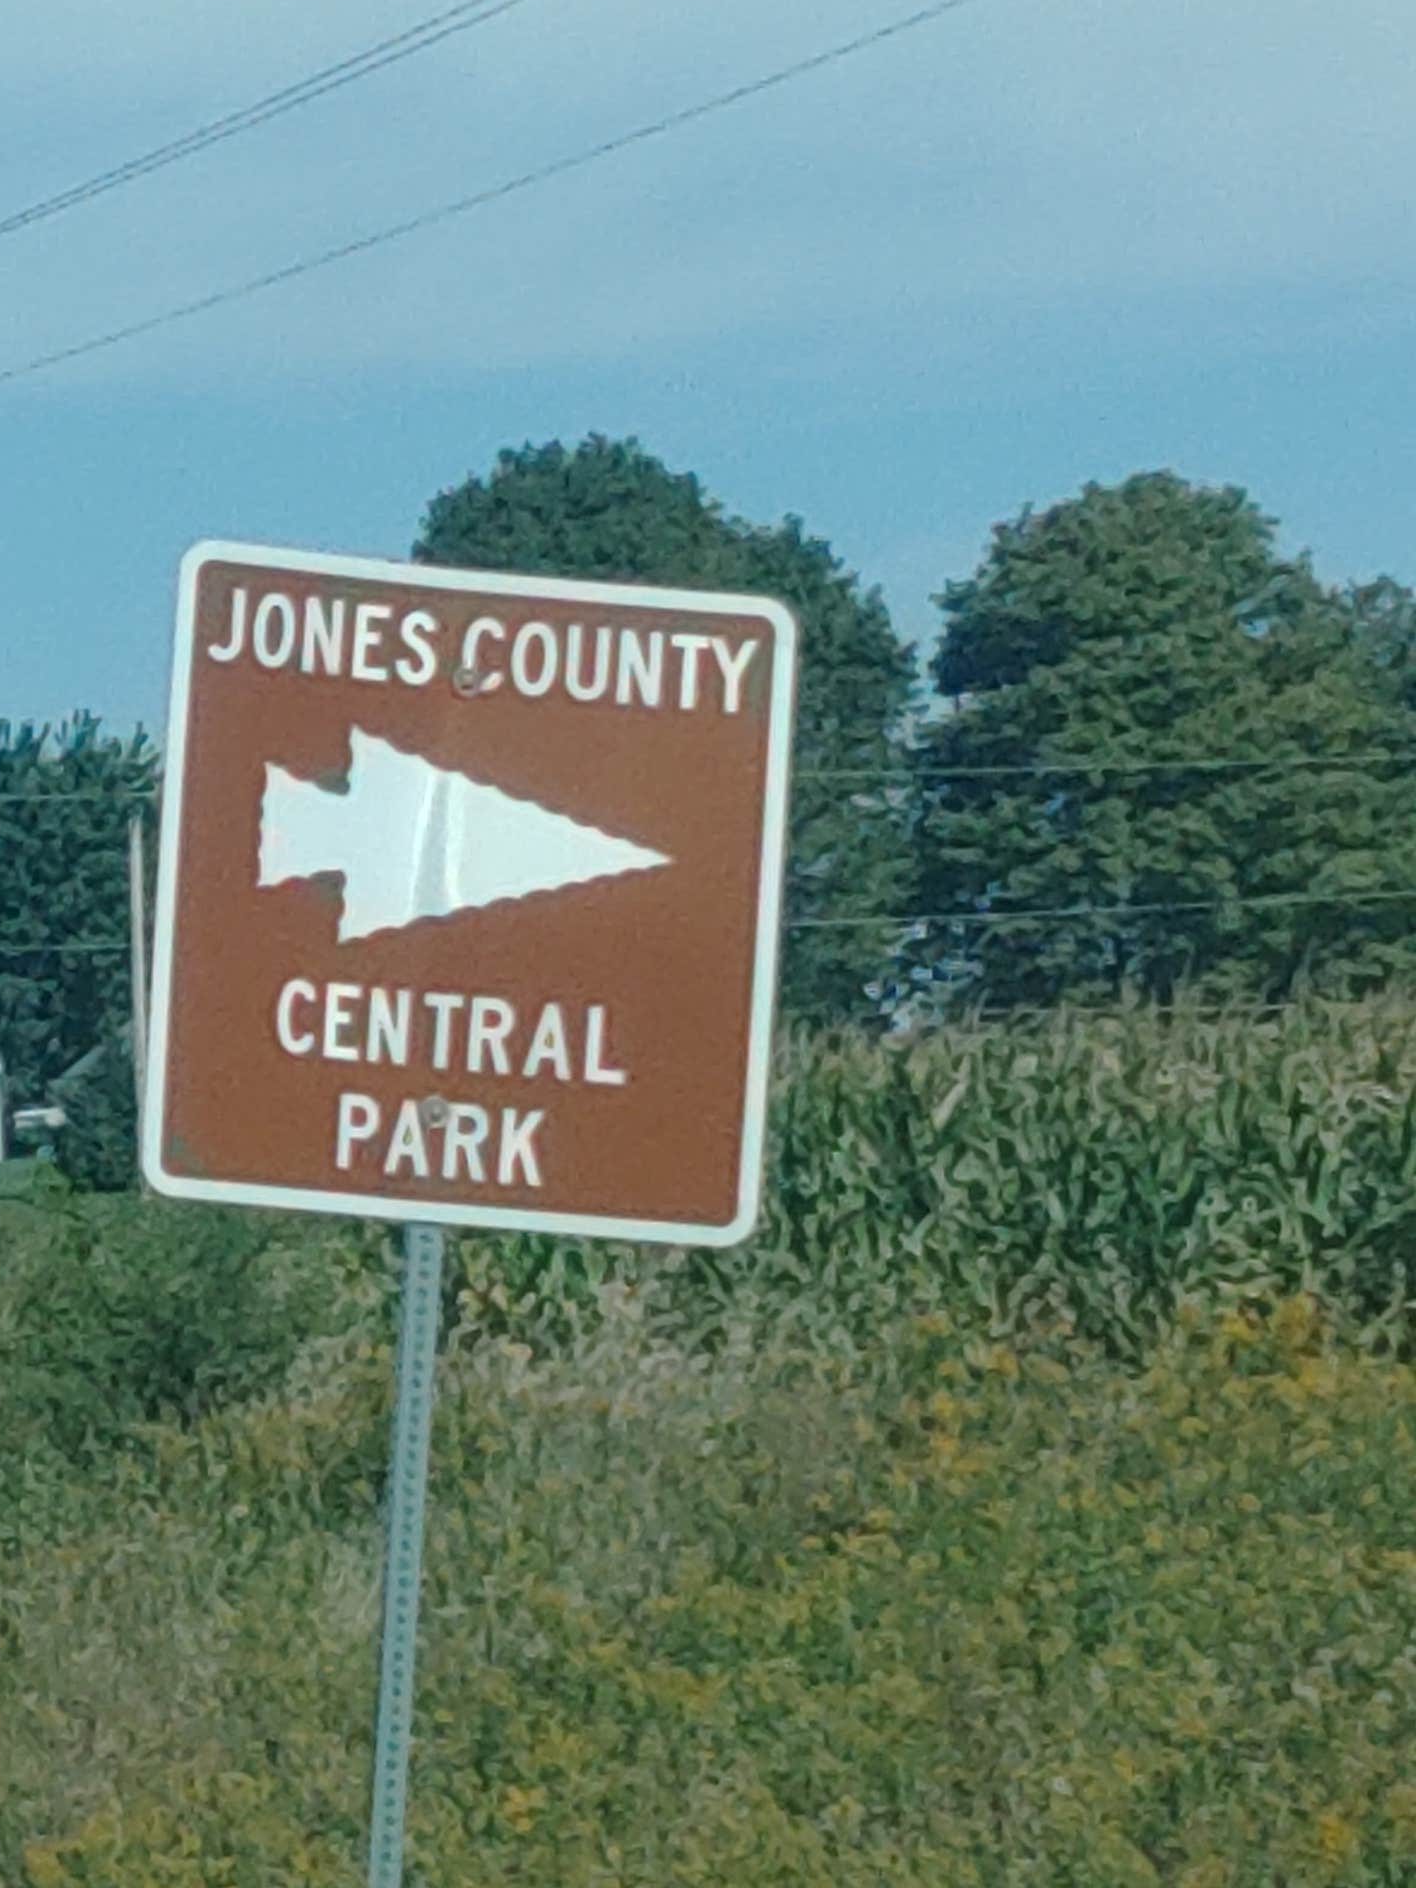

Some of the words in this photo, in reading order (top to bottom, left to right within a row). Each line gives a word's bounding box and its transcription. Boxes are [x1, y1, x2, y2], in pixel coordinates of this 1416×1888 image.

[206, 586, 439, 687] JONES
[460, 614, 760, 714] COUNTY
[276, 977, 628, 1086] CENTRAL
[335, 1092, 546, 1188] PARK
